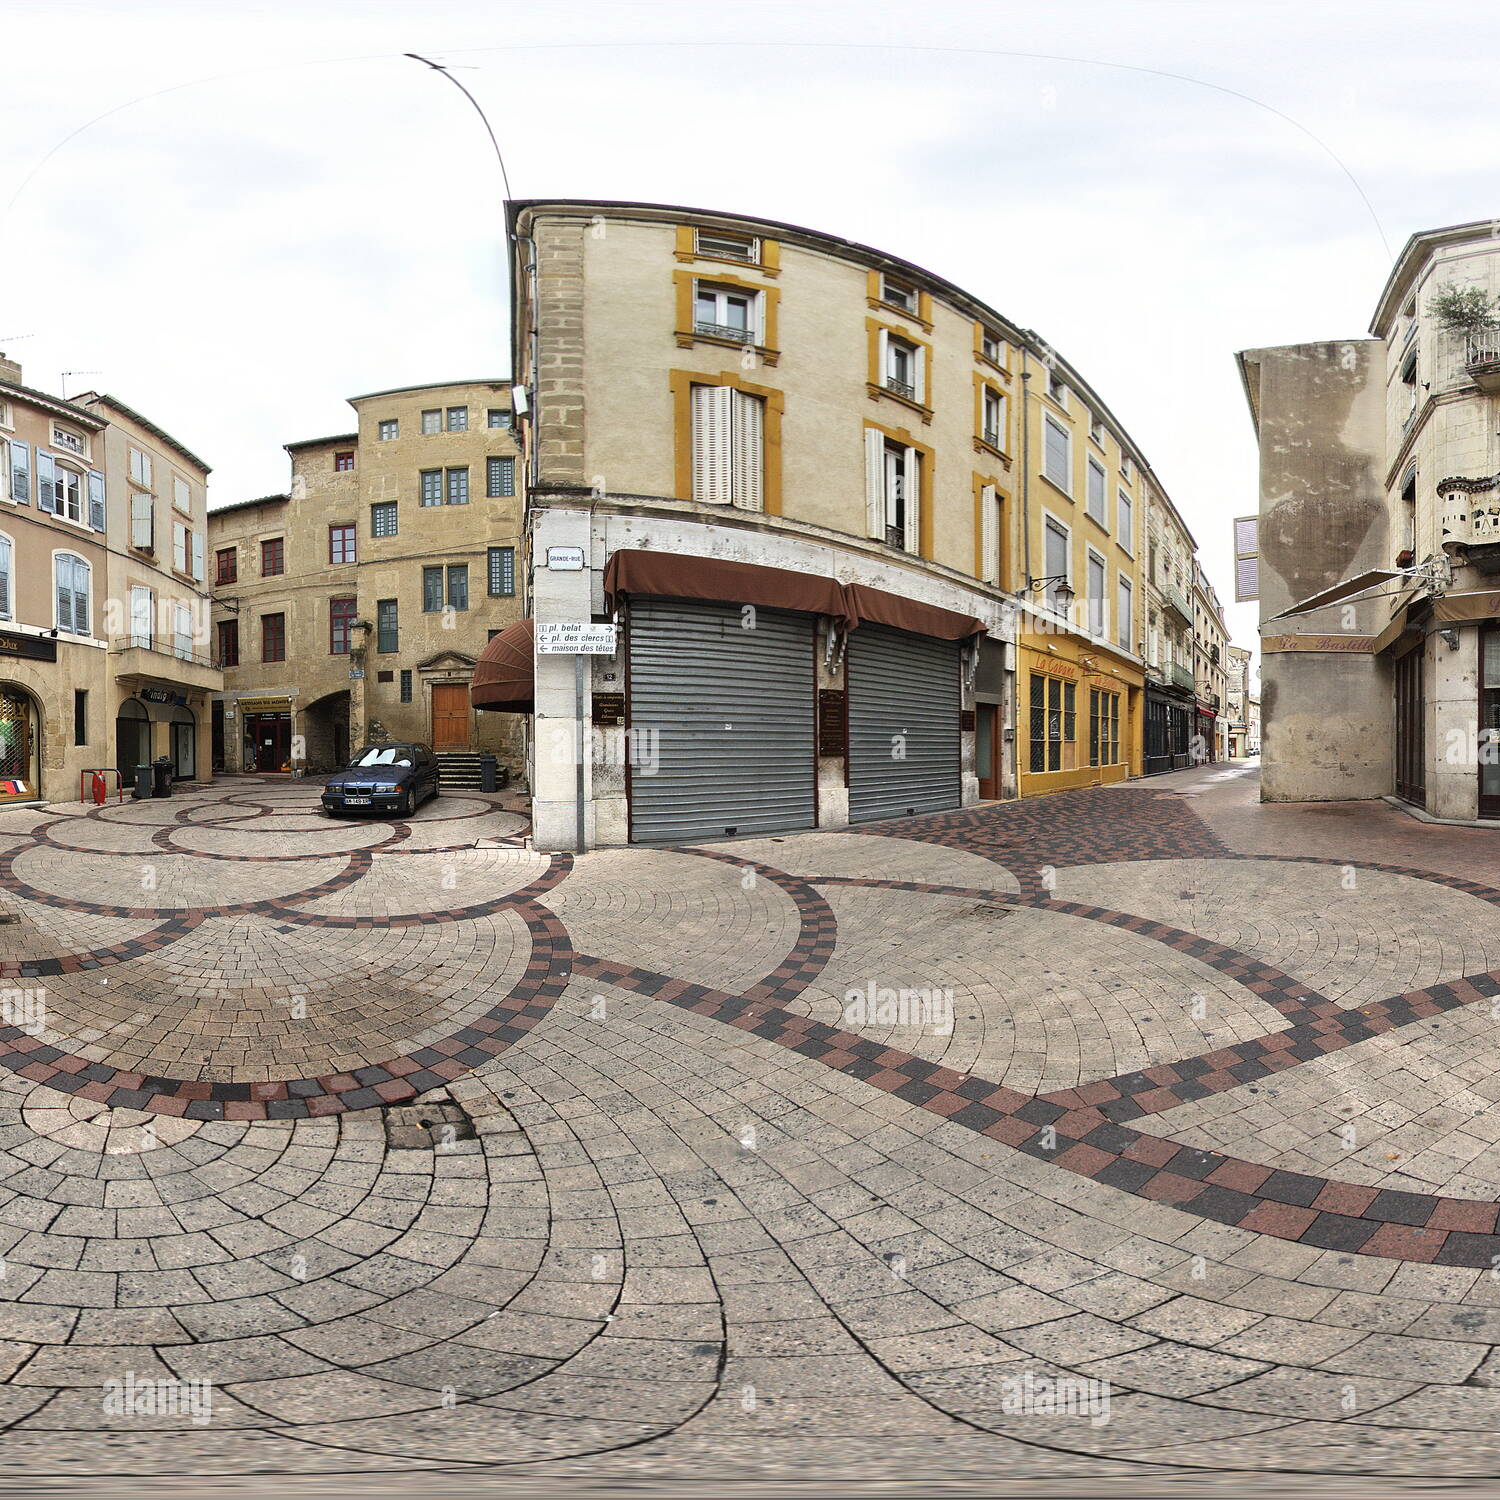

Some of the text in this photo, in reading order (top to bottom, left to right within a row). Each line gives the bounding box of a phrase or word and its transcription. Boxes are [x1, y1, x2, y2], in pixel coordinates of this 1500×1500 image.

[549, 624, 582, 632] pl. belat
[551, 634, 604, 643] pl. des clercs
[1279, 637, 1298, 650] La
[580, 644, 594, 652] des
[595, 644, 614, 653] têtes
